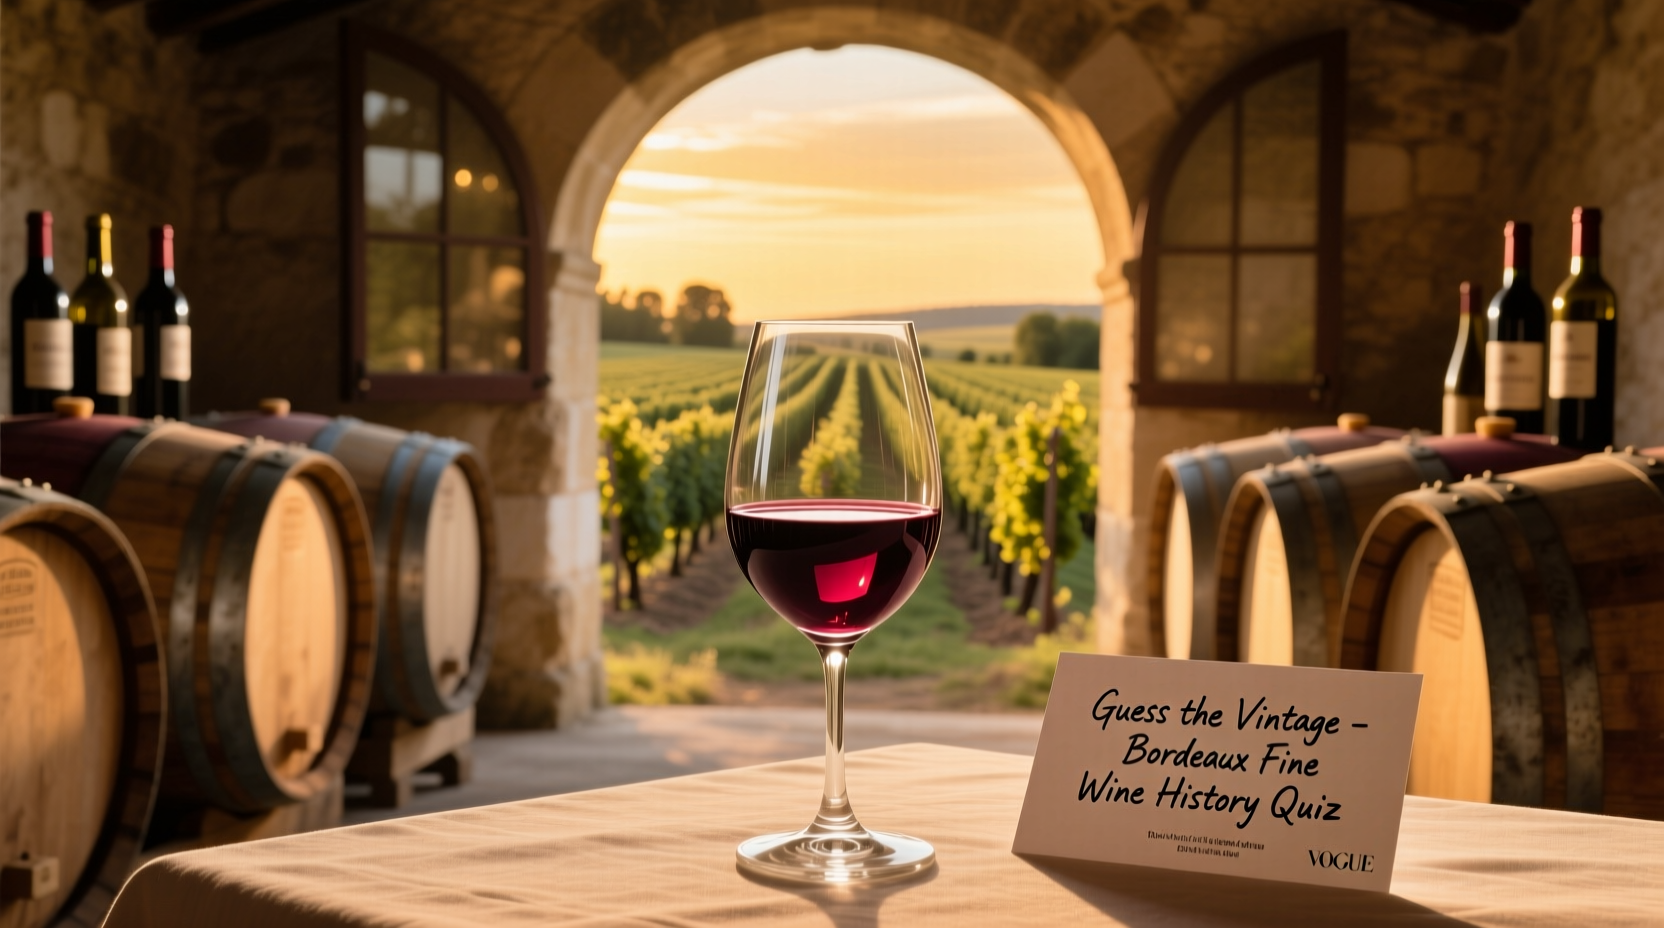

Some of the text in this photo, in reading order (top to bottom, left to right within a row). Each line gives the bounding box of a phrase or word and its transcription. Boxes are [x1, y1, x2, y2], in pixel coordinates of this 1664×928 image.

[1091, 688, 1171, 731] Guess
[1180, 695, 1224, 728] the
[1237, 696, 1340, 747] Vintage
[1121, 733, 1320, 777] Bordeaux Fine
[1077, 770, 1342, 830] Wine History Quiz
[1308, 849, 1375, 873] VOGUE
